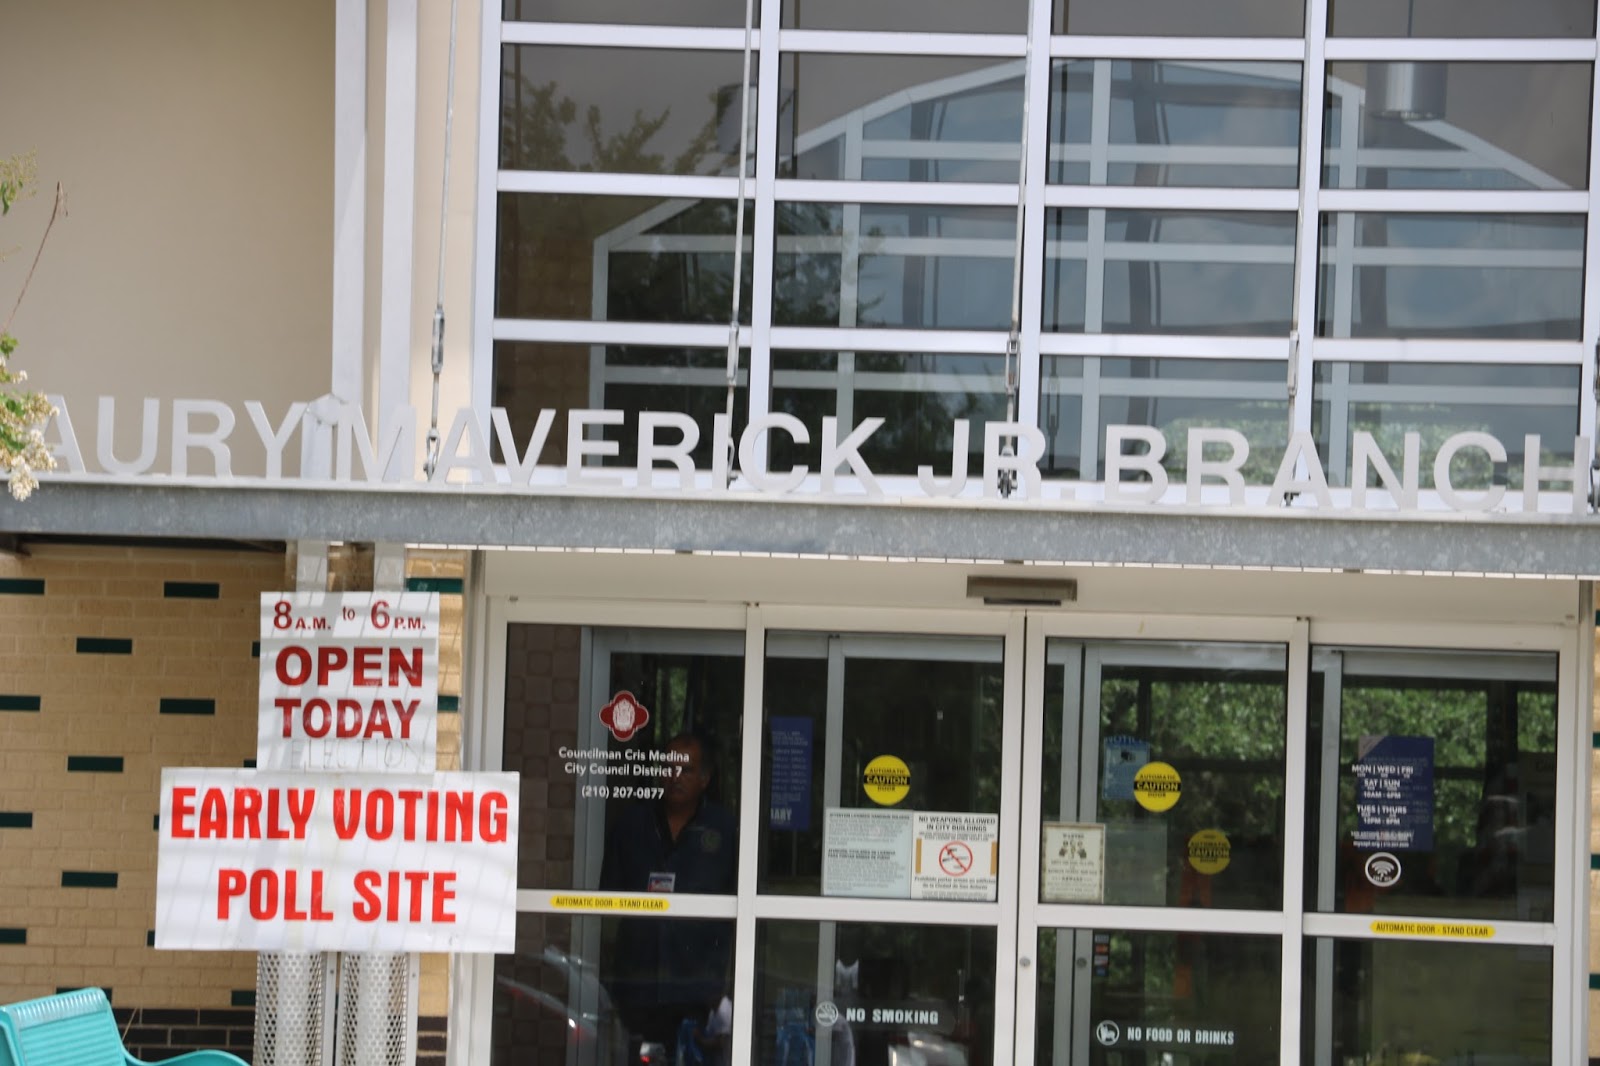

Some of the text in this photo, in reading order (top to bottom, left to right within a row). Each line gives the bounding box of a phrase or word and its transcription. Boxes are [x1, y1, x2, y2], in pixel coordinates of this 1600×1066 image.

[336, 402, 886, 494] MAVERICK
[1105, 425, 1589, 514] BRANCH
[342, 606, 355, 621] to
[275, 645, 423, 687] OPEN
[275, 698, 421, 739] TODAY
[558, 746, 690, 763] Councilman Cris Medina
[564, 762, 683, 777] City Council District 7
[1351, 764, 1372, 774] MON
[1377, 765, 1396, 774] WED
[866, 776, 908, 785] CAUTION
[1136, 782, 1178, 792] CAUTION
[581, 785, 664, 799] (210) 207-0877
[171, 788, 508, 842] EARLY VOTING
[930, 816, 962, 824] WEAPONS
[964, 817, 996, 825] ALLOWED
[1189, 848, 1230, 858] CAUTION
[217, 868, 457, 923] POLL SITE
[556, 898, 593, 908] AUTOMATIC
[595, 900, 613, 909] DOOR
[619, 900, 641, 910] STAND
[642, 901, 664, 910] CLEAR
[1376, 923, 1415, 933] AUTOMATIC
[1417, 925, 1436, 934] DOOR
[1442, 926, 1465, 935] STAND
[1466, 927, 1489, 936] CLEAR
[846, 1007, 939, 1025] NO SMOKING
[1127, 1026, 1234, 1045] NO FOOD OR DRINKS
